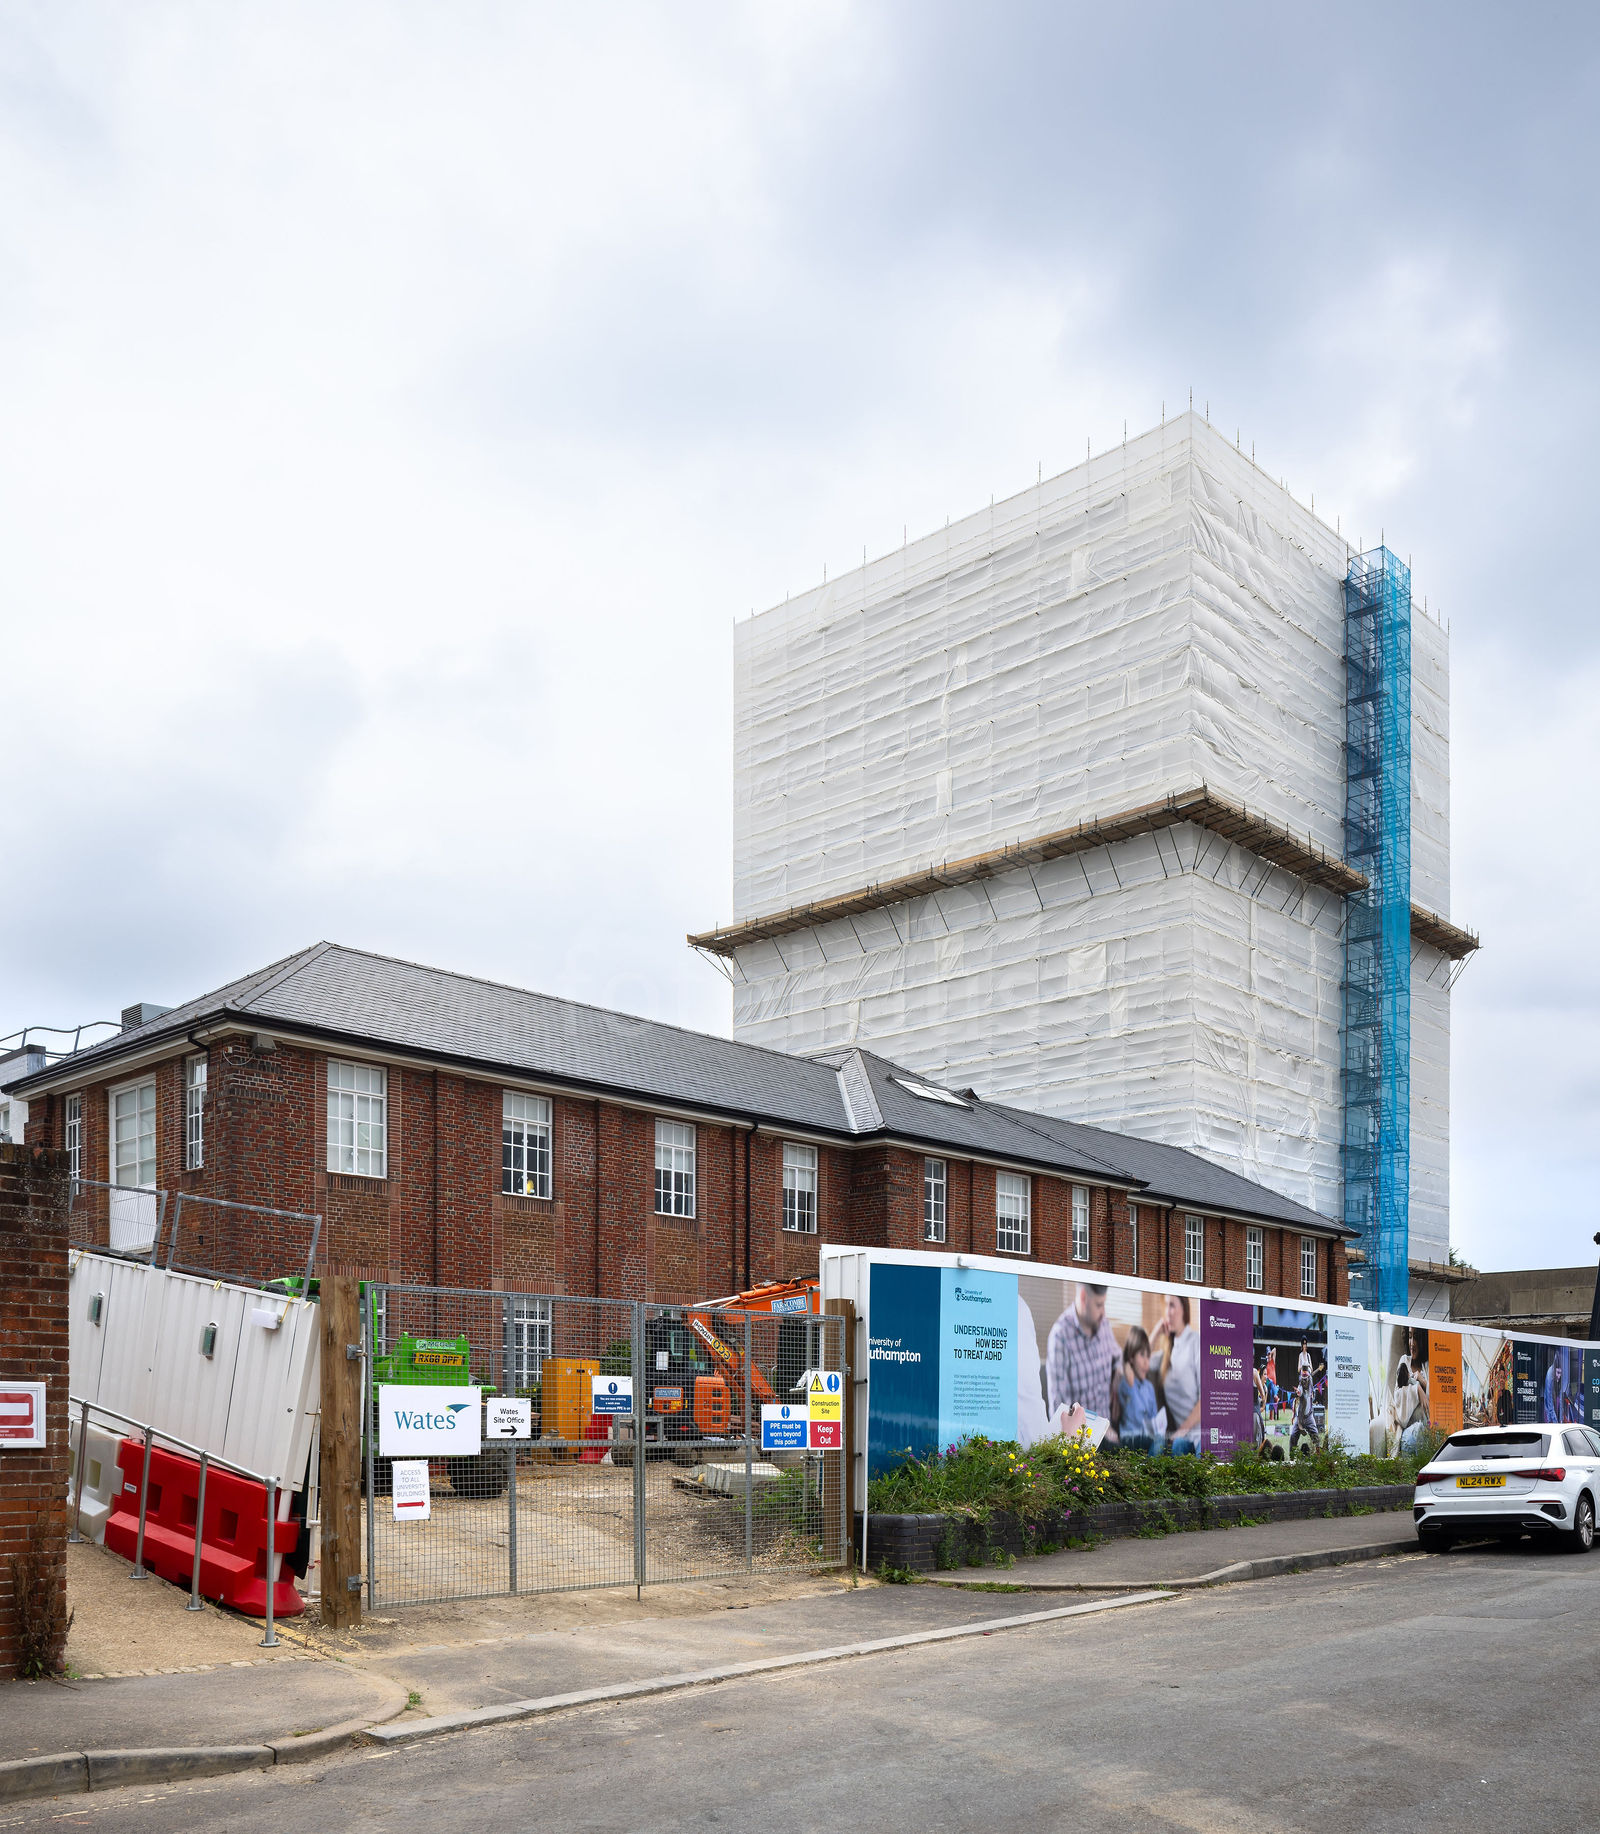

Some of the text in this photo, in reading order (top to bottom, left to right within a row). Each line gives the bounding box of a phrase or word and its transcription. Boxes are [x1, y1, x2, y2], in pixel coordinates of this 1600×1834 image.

[961, 1294, 992, 1304] Southampton
[954, 1325, 1008, 1337] UNDERSTANDING
[869, 1337, 902, 1348] niversity of
[976, 1338, 1007, 1349] HOW BEST
[870, 1347, 921, 1364] uthampton
[954, 1349, 1002, 1360] TO TREAT ADHD
[1210, 1345, 1232, 1355] MAKING
[1225, 1358, 1242, 1368] MUSIC
[1214, 1369, 1242, 1380] TOGETHER
[394, 1411, 456, 1429] Wates
[817, 1425, 833, 1434] Keep
[820, 1436, 831, 1444] Out
